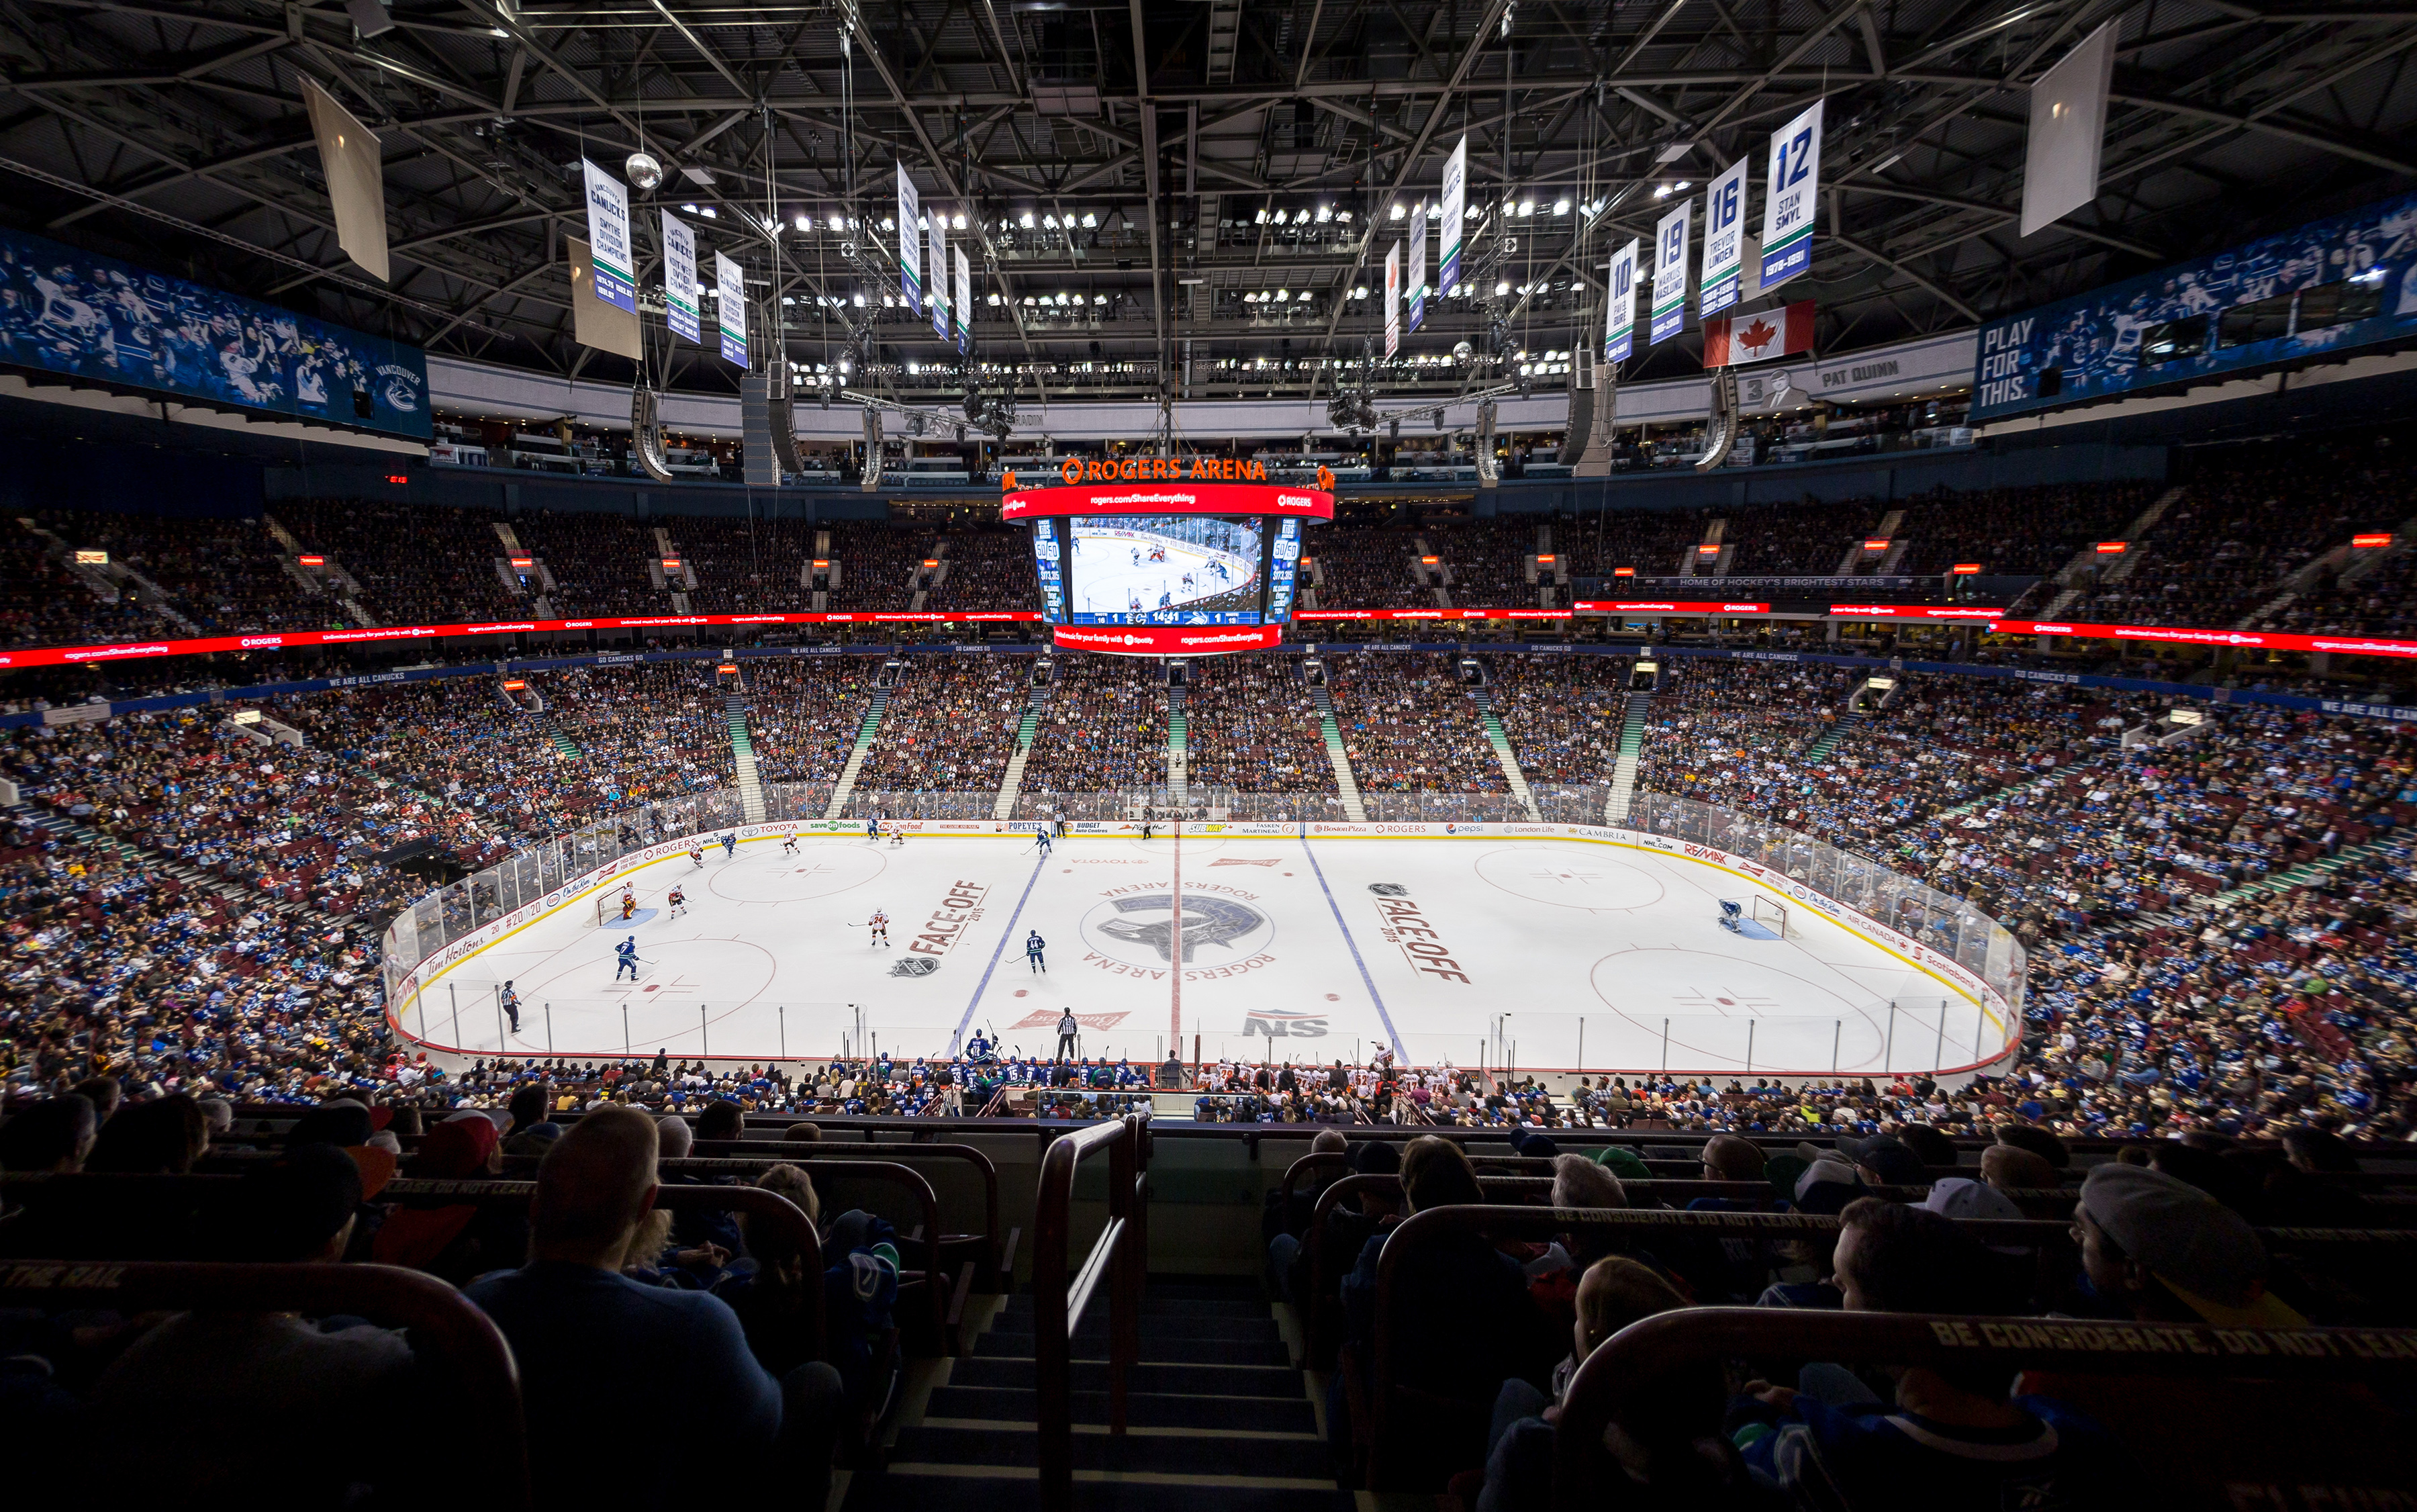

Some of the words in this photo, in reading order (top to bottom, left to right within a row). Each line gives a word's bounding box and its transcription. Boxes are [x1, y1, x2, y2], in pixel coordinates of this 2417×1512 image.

[1776, 126, 1812, 194] 12
[591, 189, 626, 222] CANUCKS
[1712, 177, 1739, 234] 16
[1778, 190, 1800, 215] STAN
[1775, 207, 1801, 232] SMYL
[599, 218, 621, 238] SMYTHE
[599, 226, 623, 250] DIVISION
[1661, 218, 1684, 270] 19
[1709, 230, 1735, 256] TREVOR
[596, 239, 627, 264] CHAMPIONS
[667, 234, 693, 261] CANUCKS
[1708, 245, 1735, 269] LINDEN
[1613, 256, 1631, 300] 10
[1983, 316, 2036, 354] PLAY
[1981, 348, 2022, 381] FOR
[375, 364, 421, 386] VANCOUVER
[1821, 370, 1847, 387] PAT
[1851, 360, 1900, 382] QUINN
[1747, 379, 1762, 401] 3
[1979, 375, 2028, 408] THIS.
[1088, 459, 1181, 480] ROGERS
[1190, 459, 1267, 481] ARENA
[1090, 493, 1196, 506] rogers.com/ShareEverything
[1287, 497, 1312, 508] ROGERS
[1680, 578, 1709, 586] HOME
[1711, 578, 1725, 586] OF
[1727, 578, 1781, 586] HOCKEY'S
[1784, 578, 1845, 586] BRIGHTEST
[1847, 578, 1885, 586] STARS
[965, 614, 1012, 622] rogers.com/ShareEverything
[1112, 613, 1119, 623] 1
[1152, 612, 1180, 622] 14:41
[1215, 613, 1221, 623] 1
[469, 624, 534, 632] rogers.com/ShareEverything
[251, 636, 283, 649] ROGERS
[1083, 635, 1094, 643] your
[1094, 634, 1110, 645] family
[1110, 636, 1124, 644] with
[1134, 636, 1154, 646] Spotify
[1180, 632, 1264, 646] rogers.com/ShareEverything
[64, 641, 169, 660] rogers.com/ShareEverything
[1768, 653, 1798, 661] CANUCKS
[329, 679, 341, 688] WE
[342, 677, 357, 686] ARE
[358, 675, 371, 685] ALL
[372, 672, 404, 683] CANUCKS
[759, 823, 799, 833] TOYOTA
[838, 821, 861, 829] foods
[1188, 823, 1227, 833] SUBWAY
[1388, 825, 1426, 833] ROGERS
[1458, 824, 1483, 833] pepsi
[1578, 827, 1627, 841] CAMBRIA
[655, 838, 696, 855] ROGERS
[1643, 839, 1673, 851] NHL.COM
[630, 853, 642, 862] BUD'S
[1684, 843, 1728, 865] RE/MAX
[599, 864, 618, 879] Budweiser
[1740, 865, 1764, 876] Budweiser
[563, 888, 572, 896] On
[580, 878, 591, 889] Run
[1795, 887, 1805, 898] Esso
[548, 896, 559, 905] Esso
[967, 907, 985, 922] 2015
[491, 925, 500, 935] 20
[1380, 926, 1401, 944] 2015
[1846, 914, 1860, 927] AIR
[1860, 920, 1897, 945] CANADA
[1031, 940, 1038, 949] 44
[427, 953, 444, 977] Tim
[1082, 951, 1167, 980] ARENA
[1186, 953, 1276, 981] ROGERS
[1926, 954, 1976, 991] Scotiabank
[1009, 1069, 1018, 1077] 15
[1027, 1072, 1032, 1082] 9
[1082, 1074, 1086, 1084] 5
[1115, 1073, 1121, 1082] 6
[1554, 1211, 1576, 1222] BE
[1721, 1215, 1756, 1227] NOT
[1758, 1216, 1803, 1229] LEAN
[1930, 1320, 1979, 1347] BE
[2213, 1327, 2269, 1355] DO
[2268, 1330, 2340, 1356] NOT
